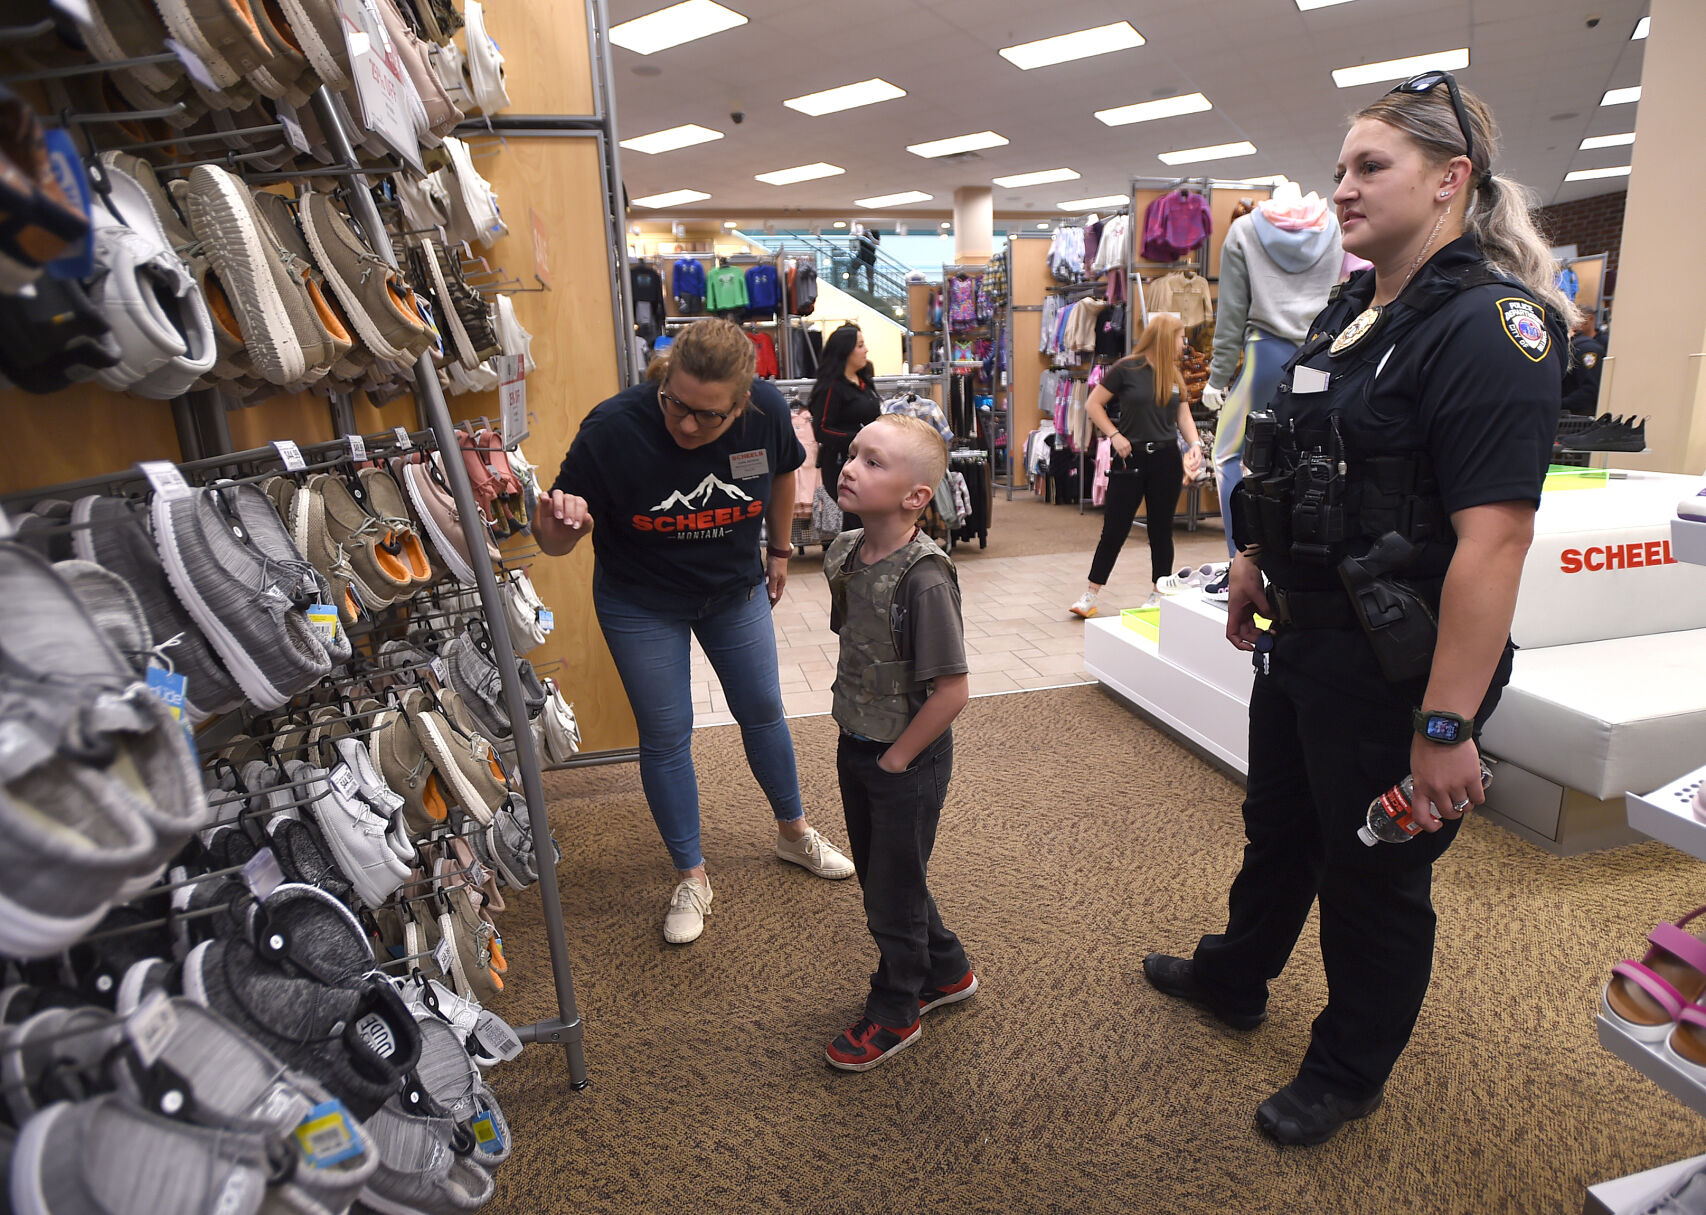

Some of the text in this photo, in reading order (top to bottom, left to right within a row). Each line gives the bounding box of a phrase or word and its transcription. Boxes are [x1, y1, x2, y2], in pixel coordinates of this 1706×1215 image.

[1509, 302, 1534, 314] POLICE
[1508, 324, 1522, 338] CITY
[1519, 339, 1529, 348] OF
[731, 450, 764, 461] SCHEELS
[632, 499, 763, 532] SCHEELS
[677, 527, 725, 540] MONTANA
[1560, 540, 1679, 574] SCHEEL
[360, 1015, 393, 1057] DUDE
